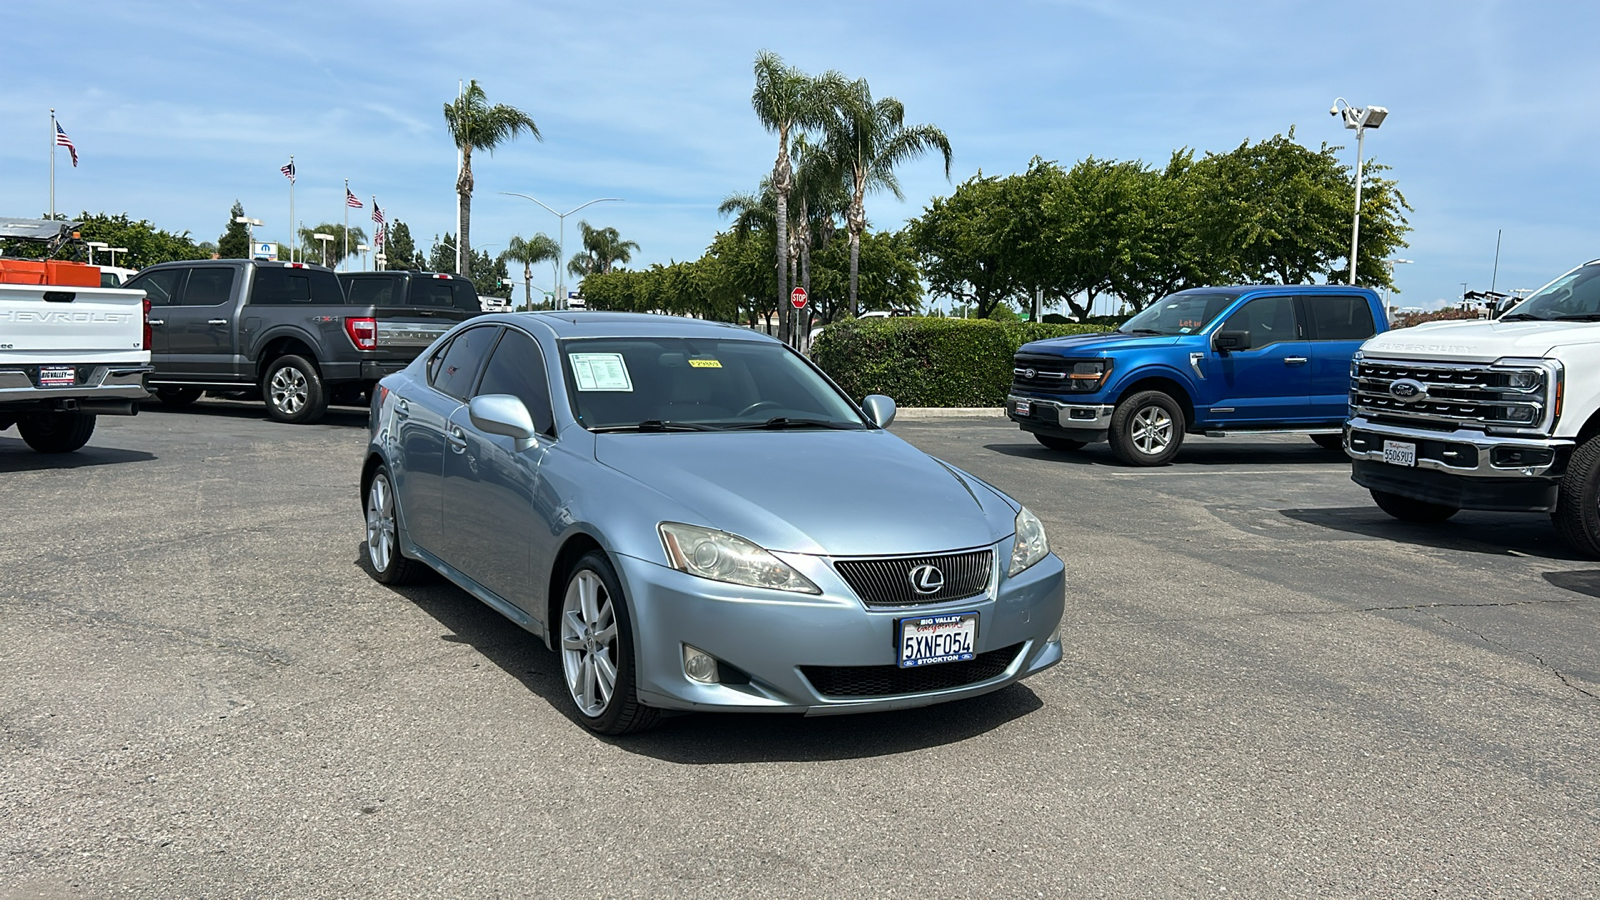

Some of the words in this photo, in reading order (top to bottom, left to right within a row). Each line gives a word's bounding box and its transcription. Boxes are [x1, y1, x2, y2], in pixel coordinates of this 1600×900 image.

[793, 294, 806, 302] STOP
[1179, 319, 1192, 327] Let
[1395, 385, 1414, 396] Ford
[905, 632, 970, 658] 5XNF054
[917, 655, 958, 665] STOCKTON
